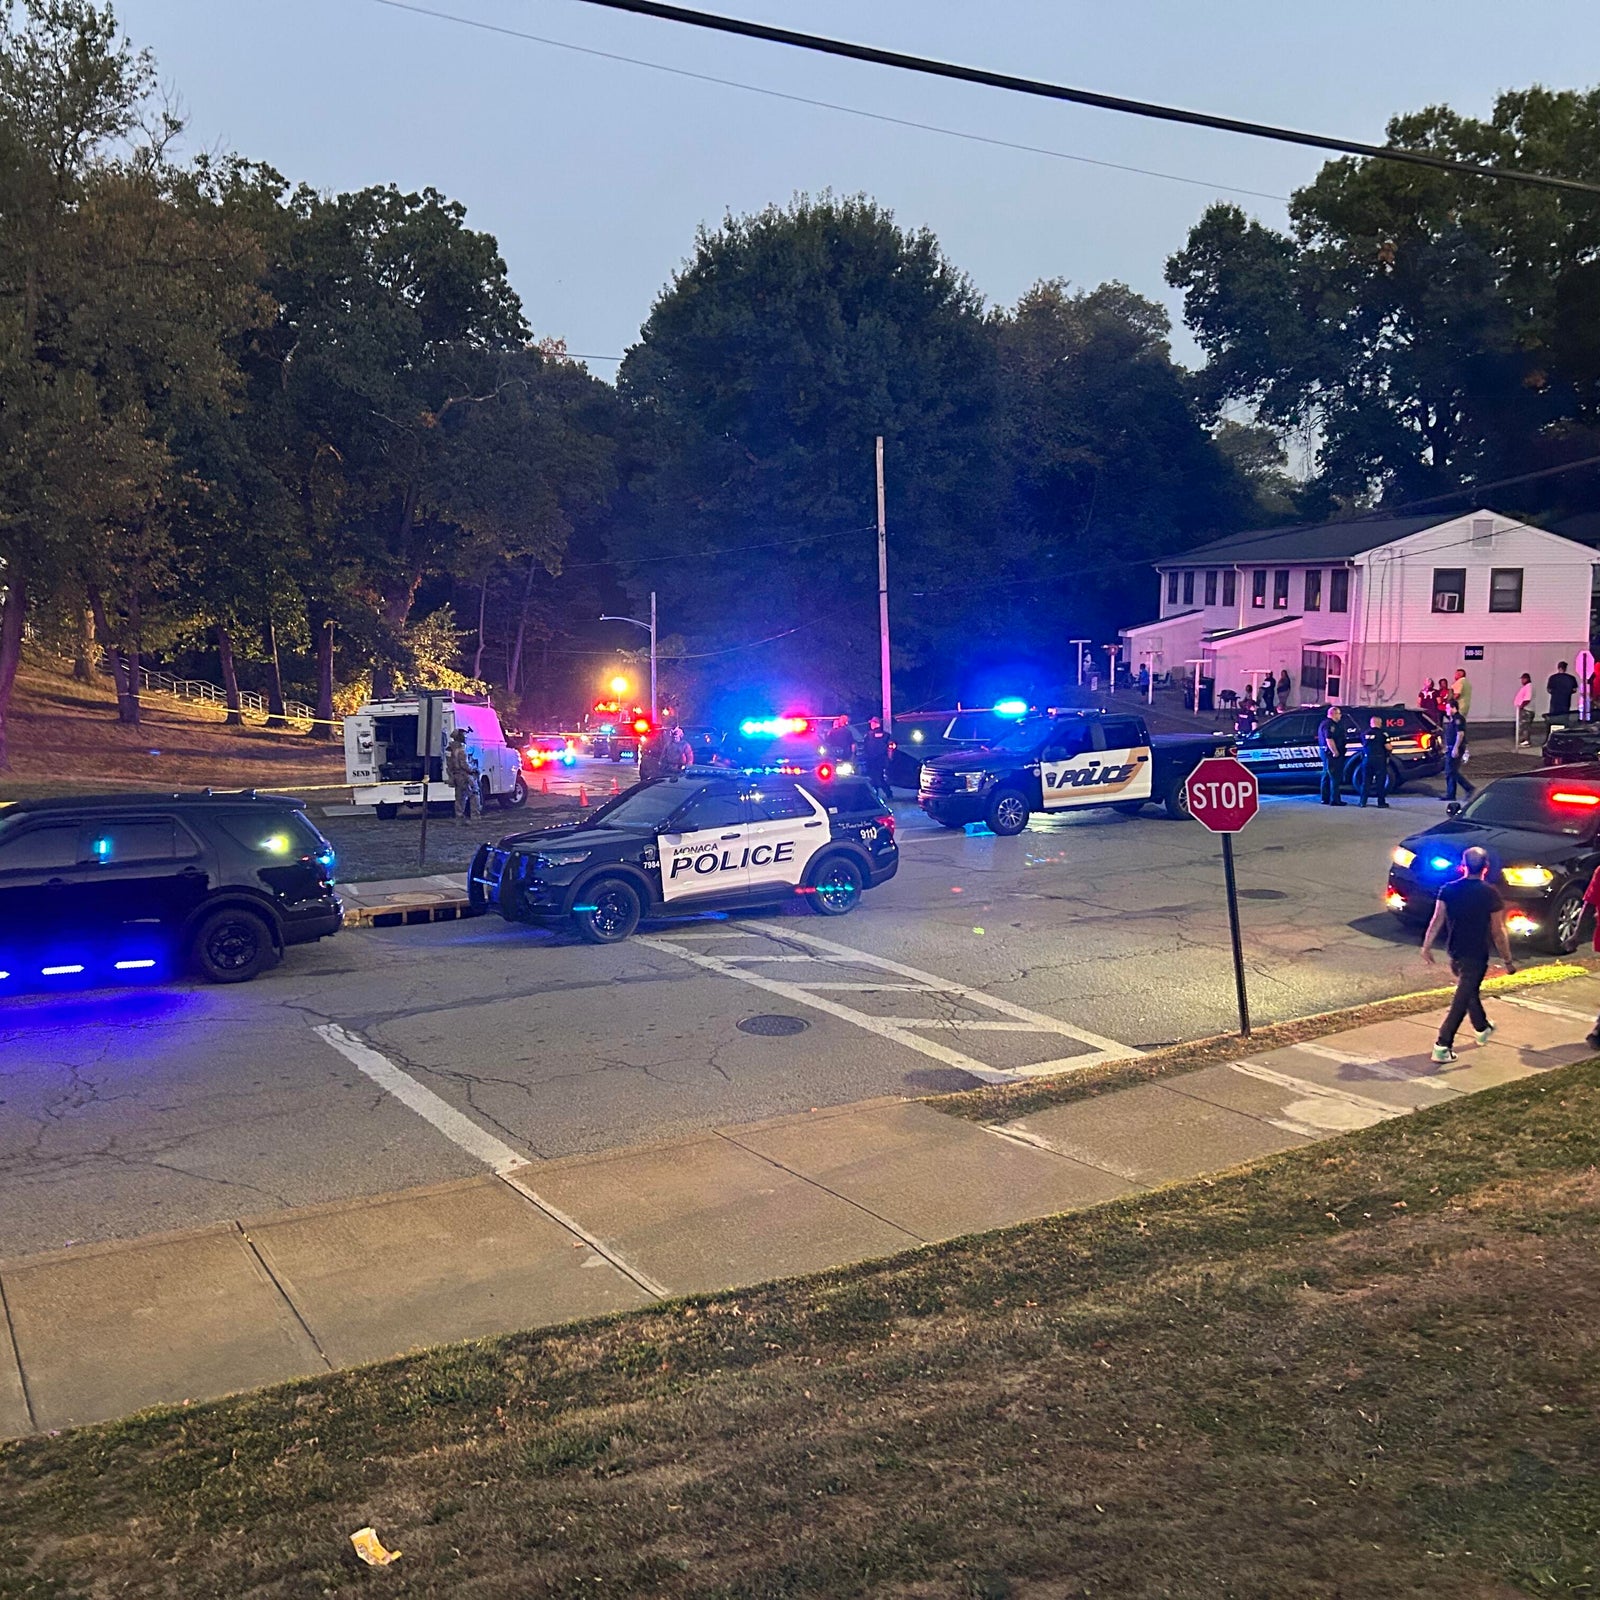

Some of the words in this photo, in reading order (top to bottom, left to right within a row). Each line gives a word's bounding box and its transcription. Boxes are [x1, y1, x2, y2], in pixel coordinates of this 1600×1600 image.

[1385, 718, 1405, 727] K-9
[1270, 745, 1321, 761] SHERI
[1056, 763, 1137, 788] POLICE
[1192, 781, 1253, 809] STOP
[670, 841, 794, 878] POLICE
[673, 843, 718, 856] MONACA
